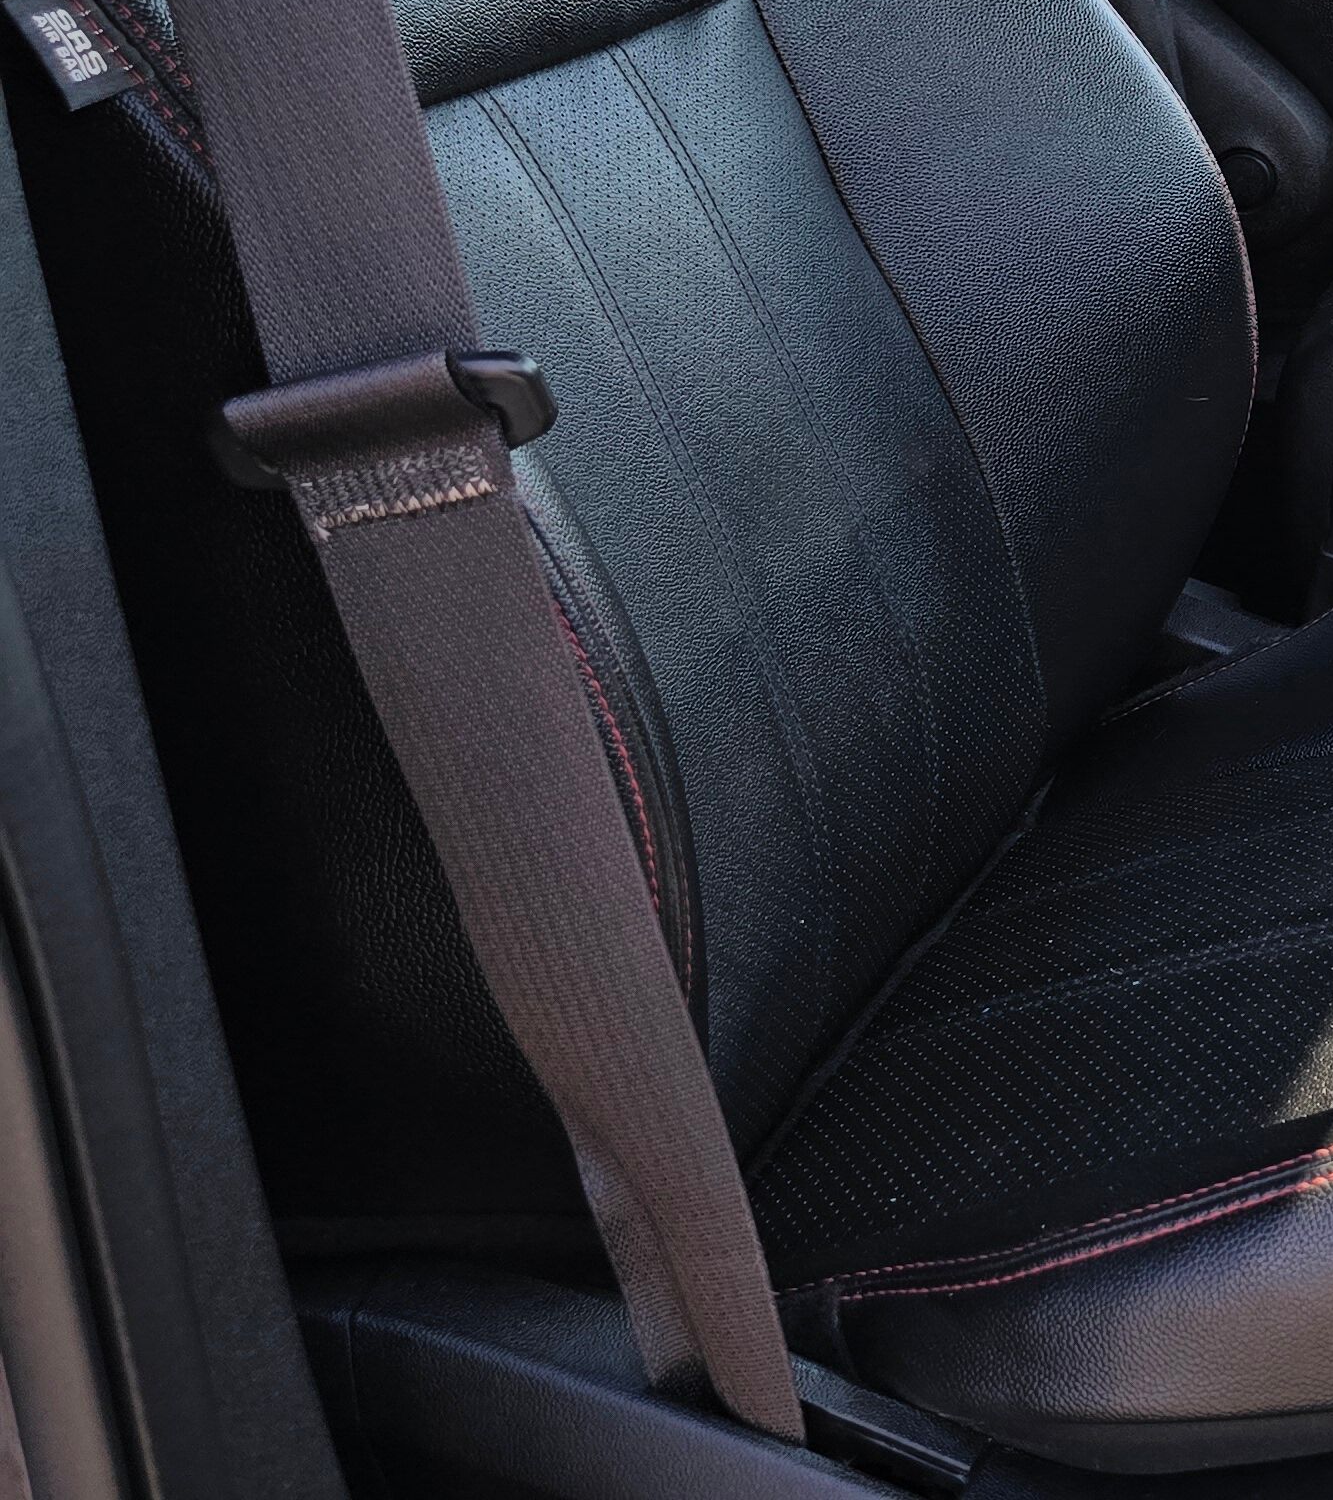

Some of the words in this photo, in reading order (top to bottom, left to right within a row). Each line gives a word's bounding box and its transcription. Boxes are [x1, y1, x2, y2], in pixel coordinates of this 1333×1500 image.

[31, 14, 63, 45] AIR
[53, 45, 92, 82] BAG
[49, 8, 108, 77] SRS
